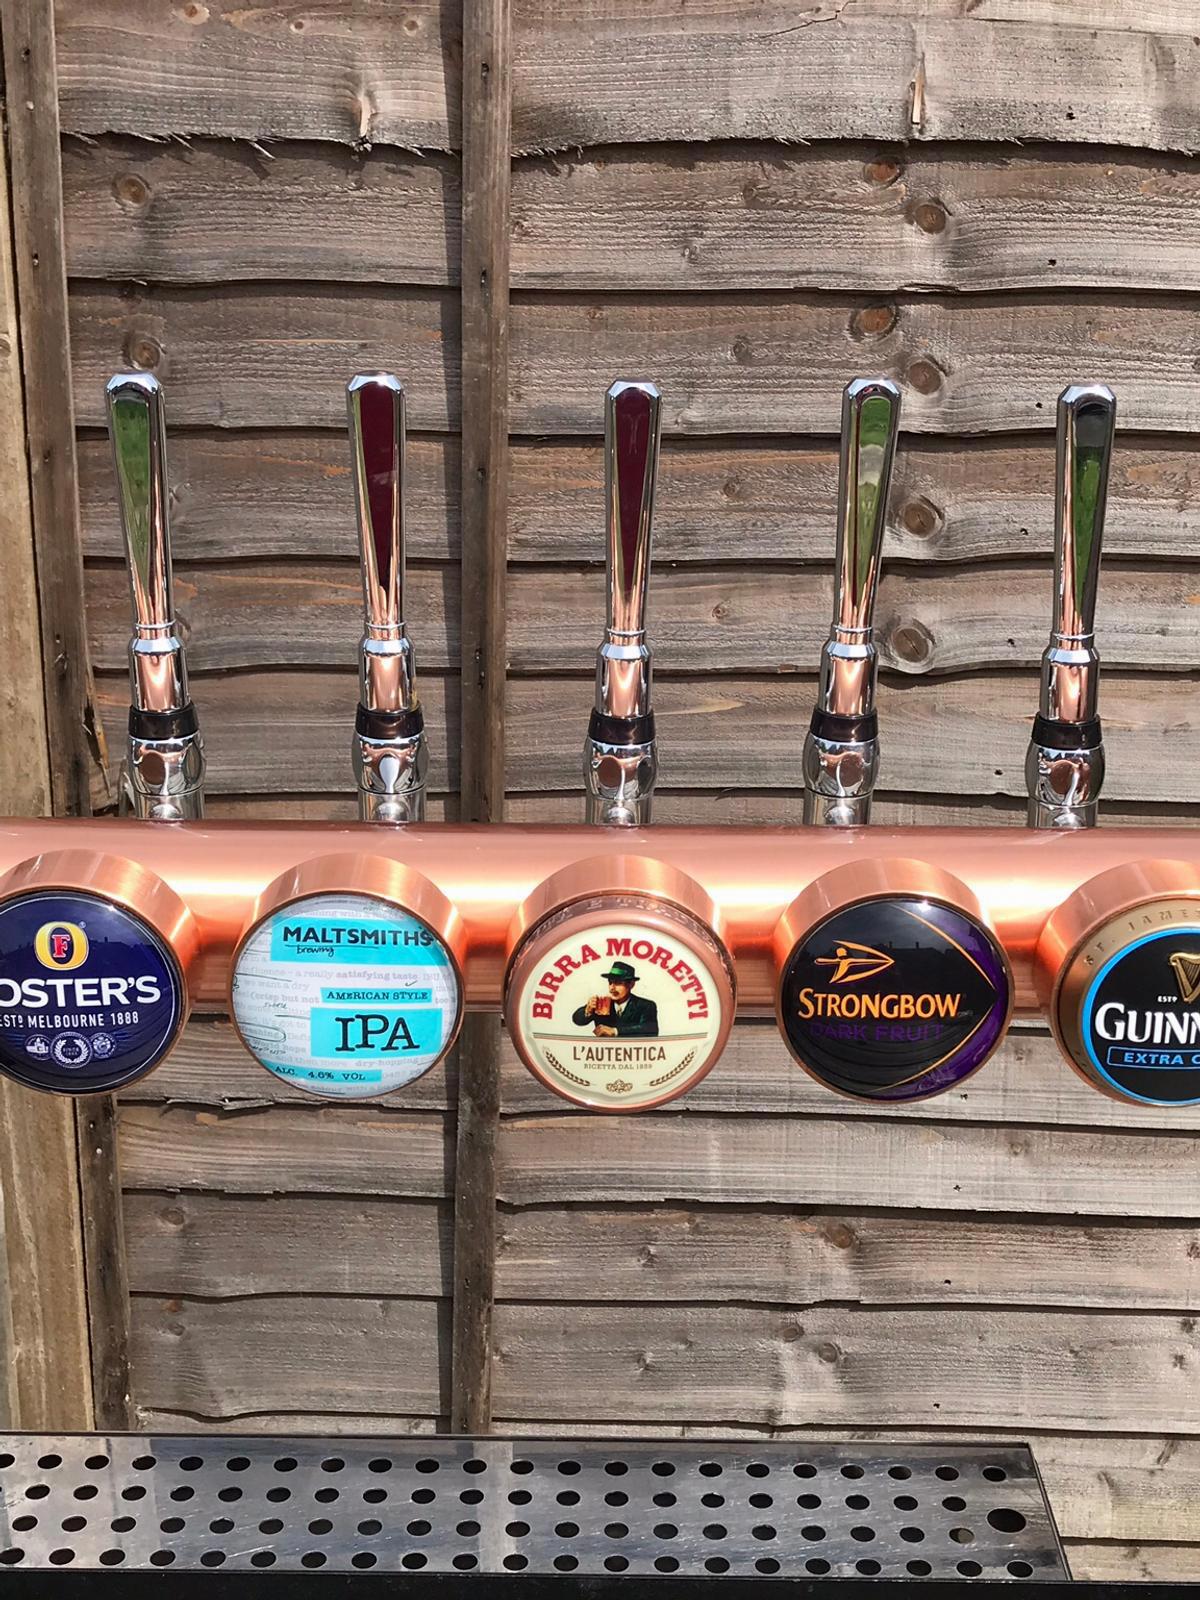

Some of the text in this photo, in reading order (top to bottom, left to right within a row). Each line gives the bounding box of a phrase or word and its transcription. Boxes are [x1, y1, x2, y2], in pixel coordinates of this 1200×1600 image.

[283, 926, 433, 946] MALTSMITHS
[297, 944, 335, 957] brewing
[532, 937, 709, 1020] BIRRA MORETTI
[326, 991, 428, 1001] AMERICAN STYLE
[798, 988, 961, 1019] STRONGBOW
[27, 1013, 104, 1028] MELBOURNE
[110, 1010, 139, 1026] 1888
[335, 1014, 420, 1052] IPA
[810, 1023, 945, 1042] DARK FRUIT
[573, 1045, 666, 1062] L'AUTENTICA
[1123, 1052, 1184, 1065] EXTRA
[584, 1063, 617, 1071] RICETTA
[342, 1073, 366, 1081] VOL
